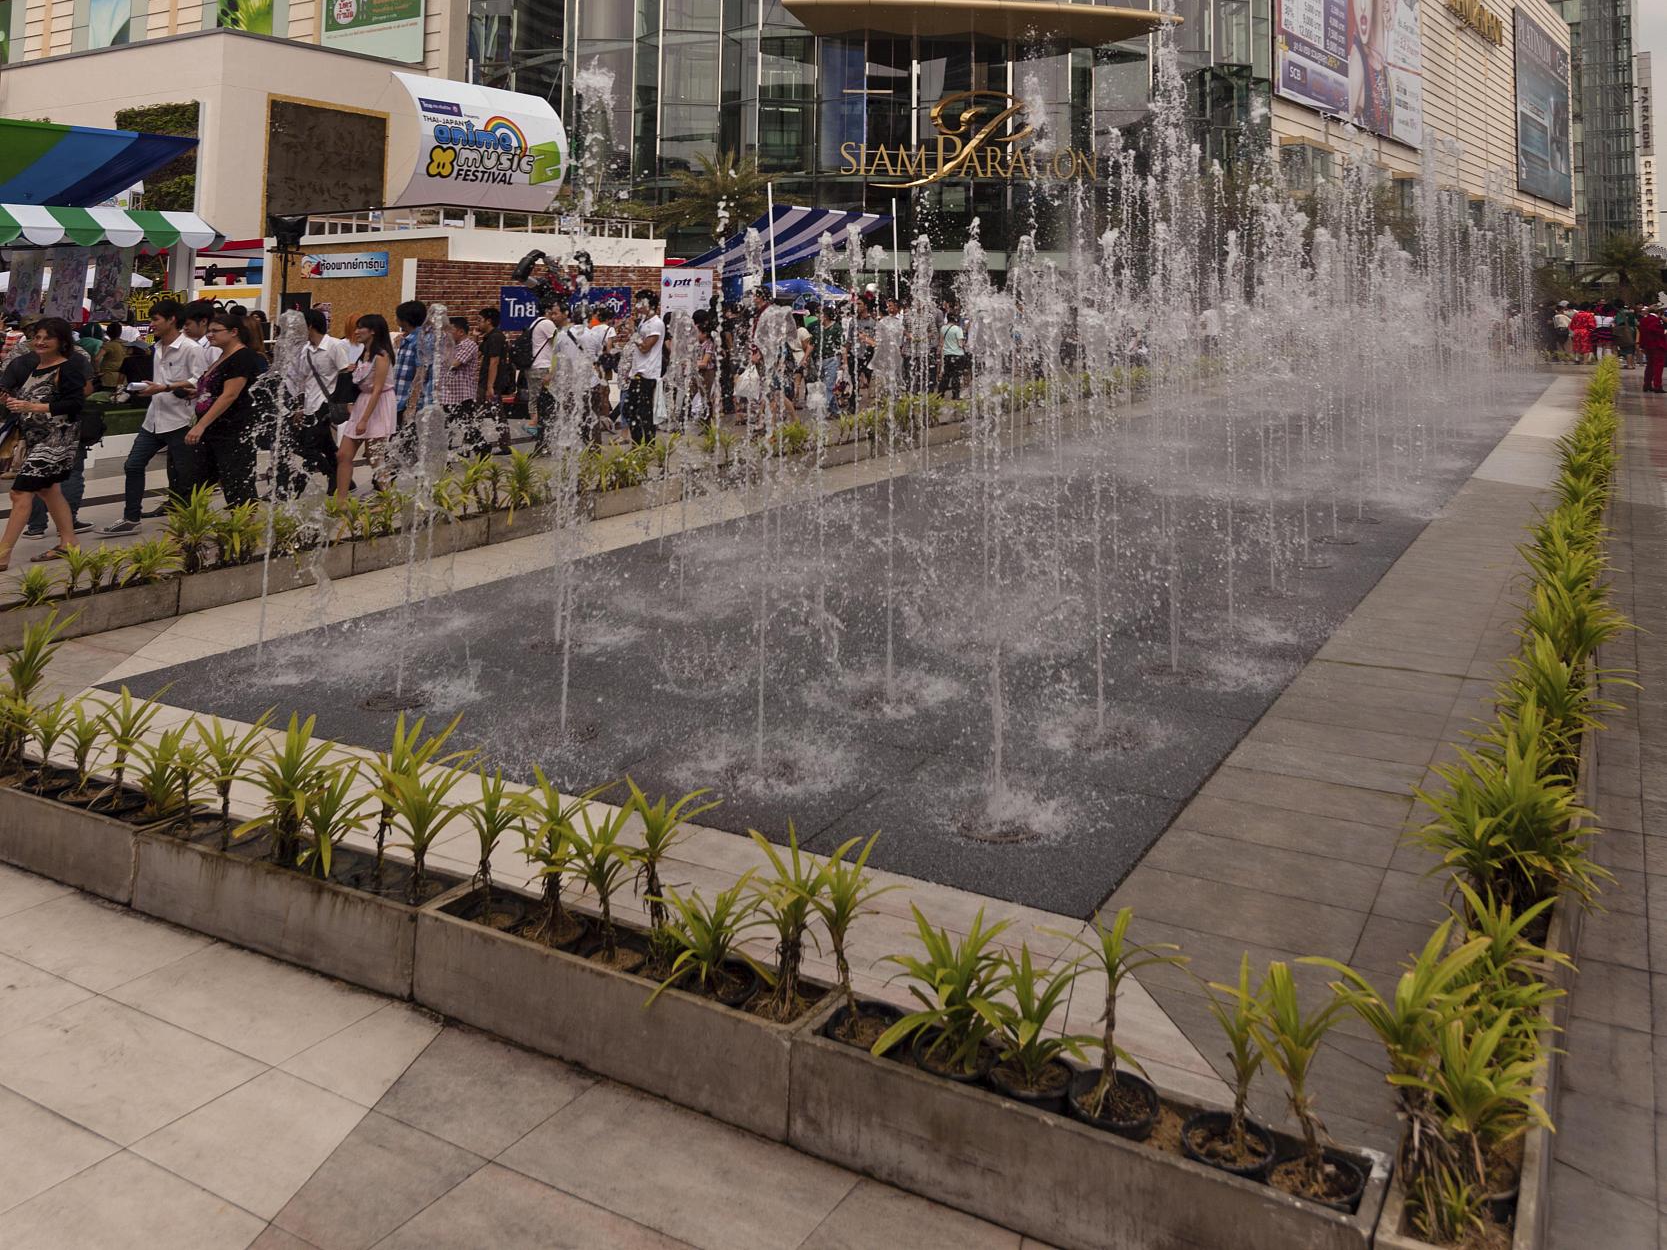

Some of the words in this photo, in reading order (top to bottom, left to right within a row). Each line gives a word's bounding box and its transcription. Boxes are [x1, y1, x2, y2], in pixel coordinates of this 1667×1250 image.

[1289, 66, 1301, 81] SCB
[423, 115, 464, 127] THAI-JAPAN
[1641, 86, 1650, 150] PARAGON
[434, 120, 513, 151] anime
[457, 147, 536, 175] music
[840, 141, 927, 176] SIAM
[454, 169, 514, 186] FESTIVAL
[1644, 160, 1655, 239] CINEPLEX
[320, 257, 386, 272] ห้องพากย์การ์ตูน
[673, 278, 692, 288] ptt
